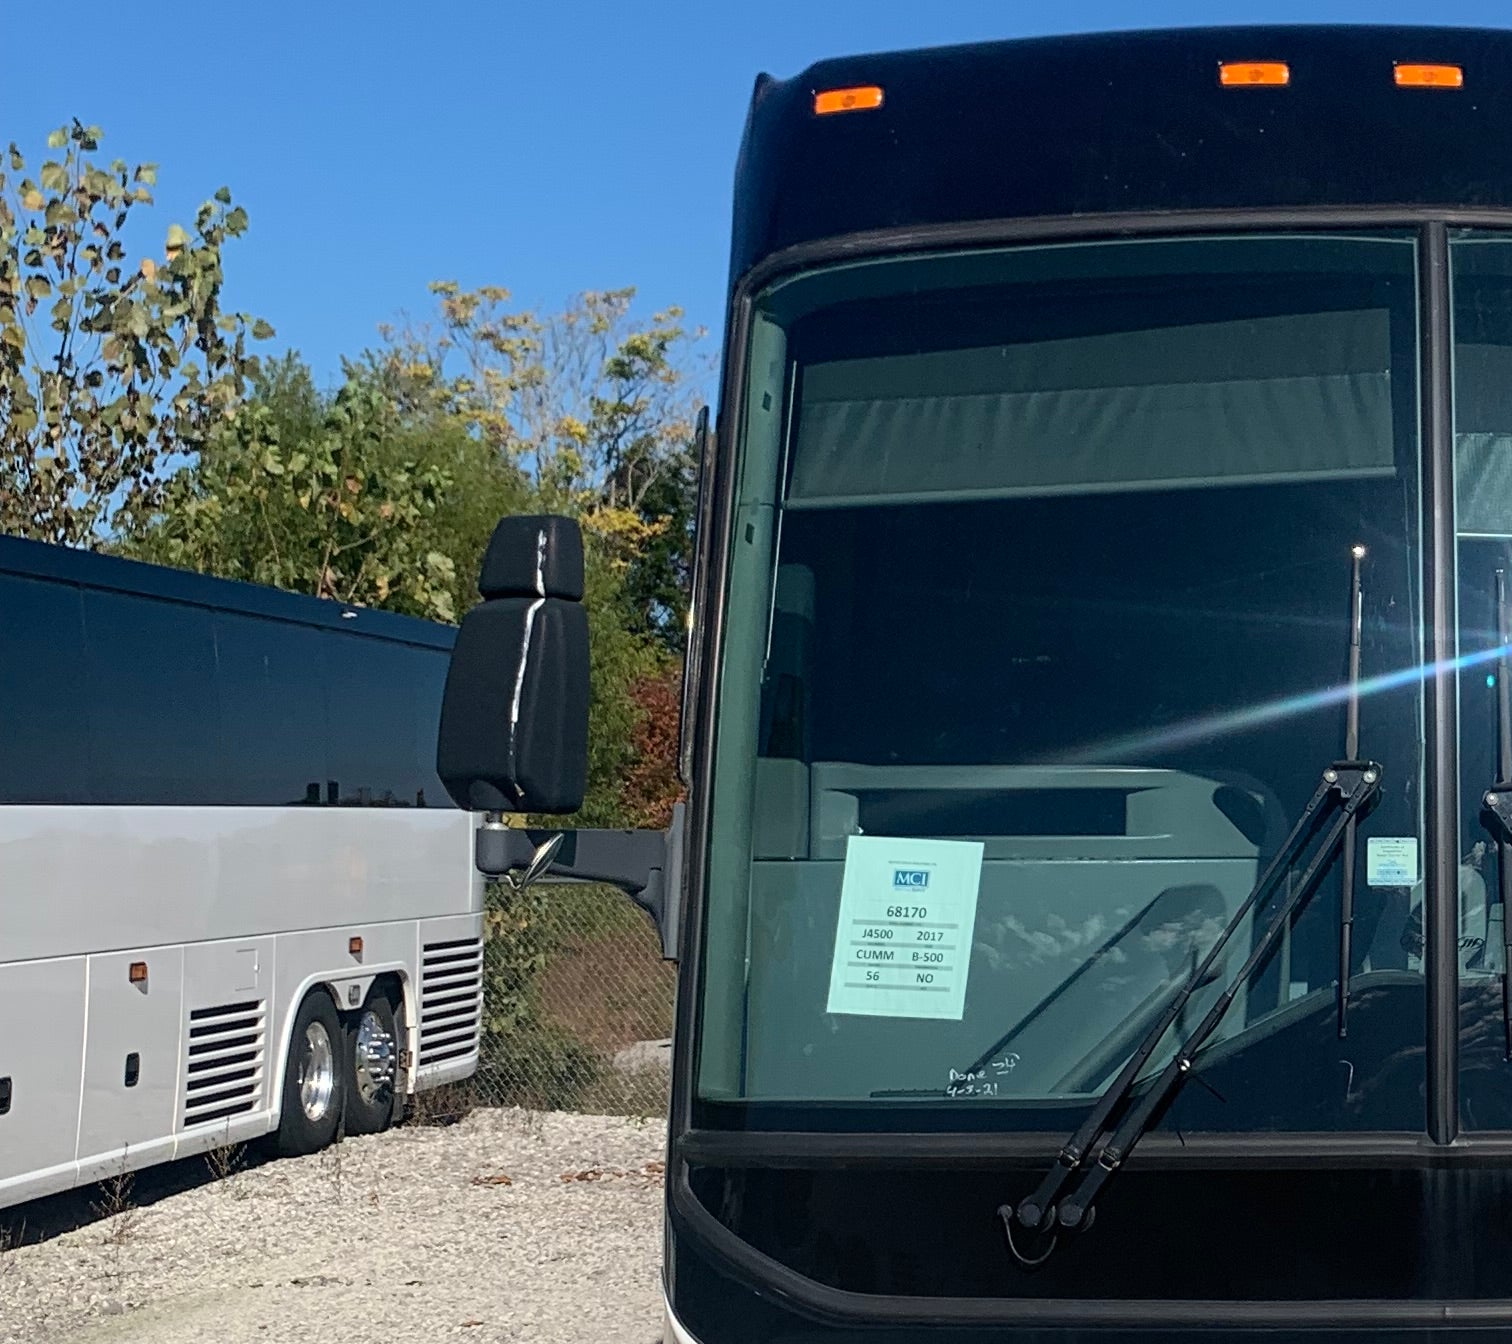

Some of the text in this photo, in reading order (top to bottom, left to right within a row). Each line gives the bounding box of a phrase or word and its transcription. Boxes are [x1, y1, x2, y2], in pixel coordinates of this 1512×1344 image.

[896, 872, 927, 886] MCI
[887, 906, 927, 918] 68170
[862, 929, 894, 939] J4500
[916, 931, 944, 941] 2017
[856, 949, 895, 960] CUMM
[912, 952, 944, 962] B-500
[866, 971, 880, 981] 56
[916, 973, 934, 984] NO
